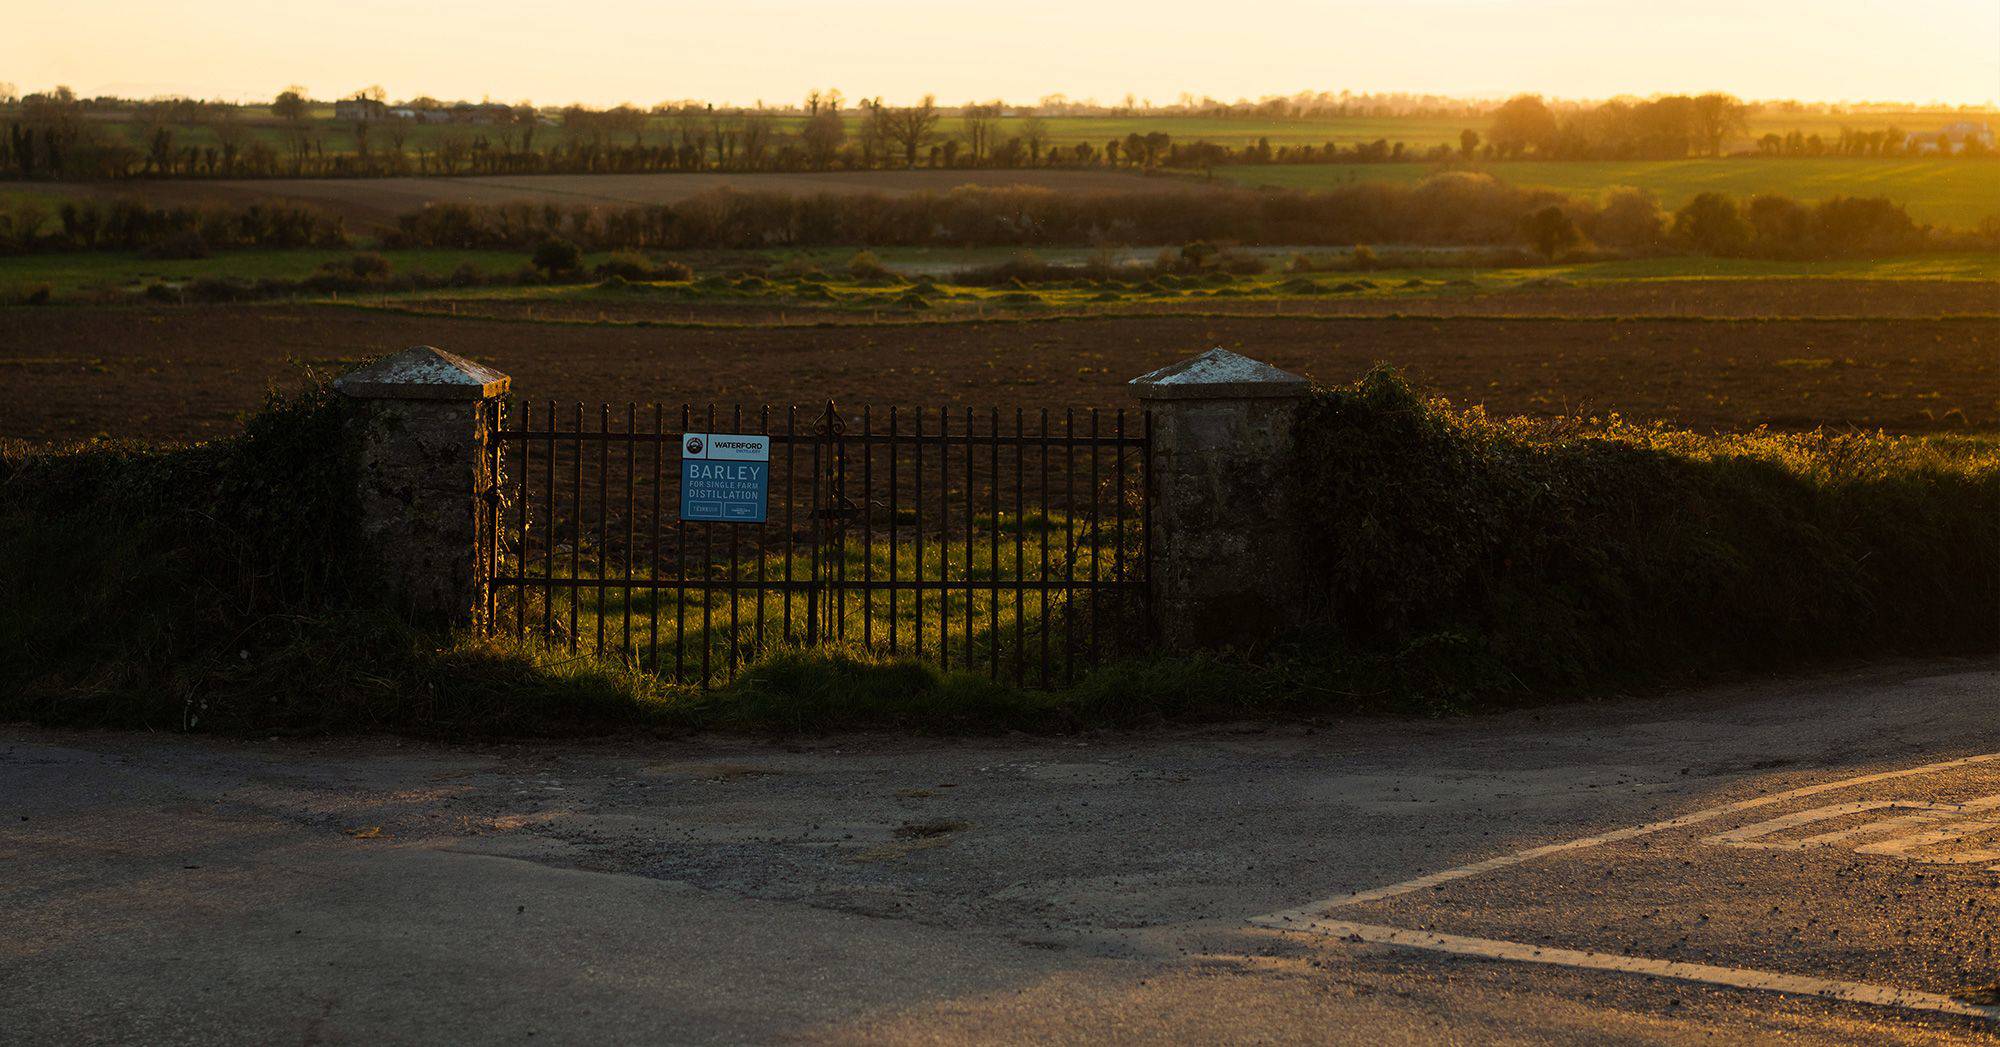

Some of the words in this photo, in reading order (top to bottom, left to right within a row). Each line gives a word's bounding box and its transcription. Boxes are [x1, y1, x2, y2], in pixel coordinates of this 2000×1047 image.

[714, 441, 763, 450] WATERFORD
[690, 464, 760, 481] BARLEY
[689, 480, 704, 488] FOR
[706, 481, 735, 489] SINGLE
[737, 482, 758, 490] FARM
[689, 489, 758, 500] DISTILLATION
